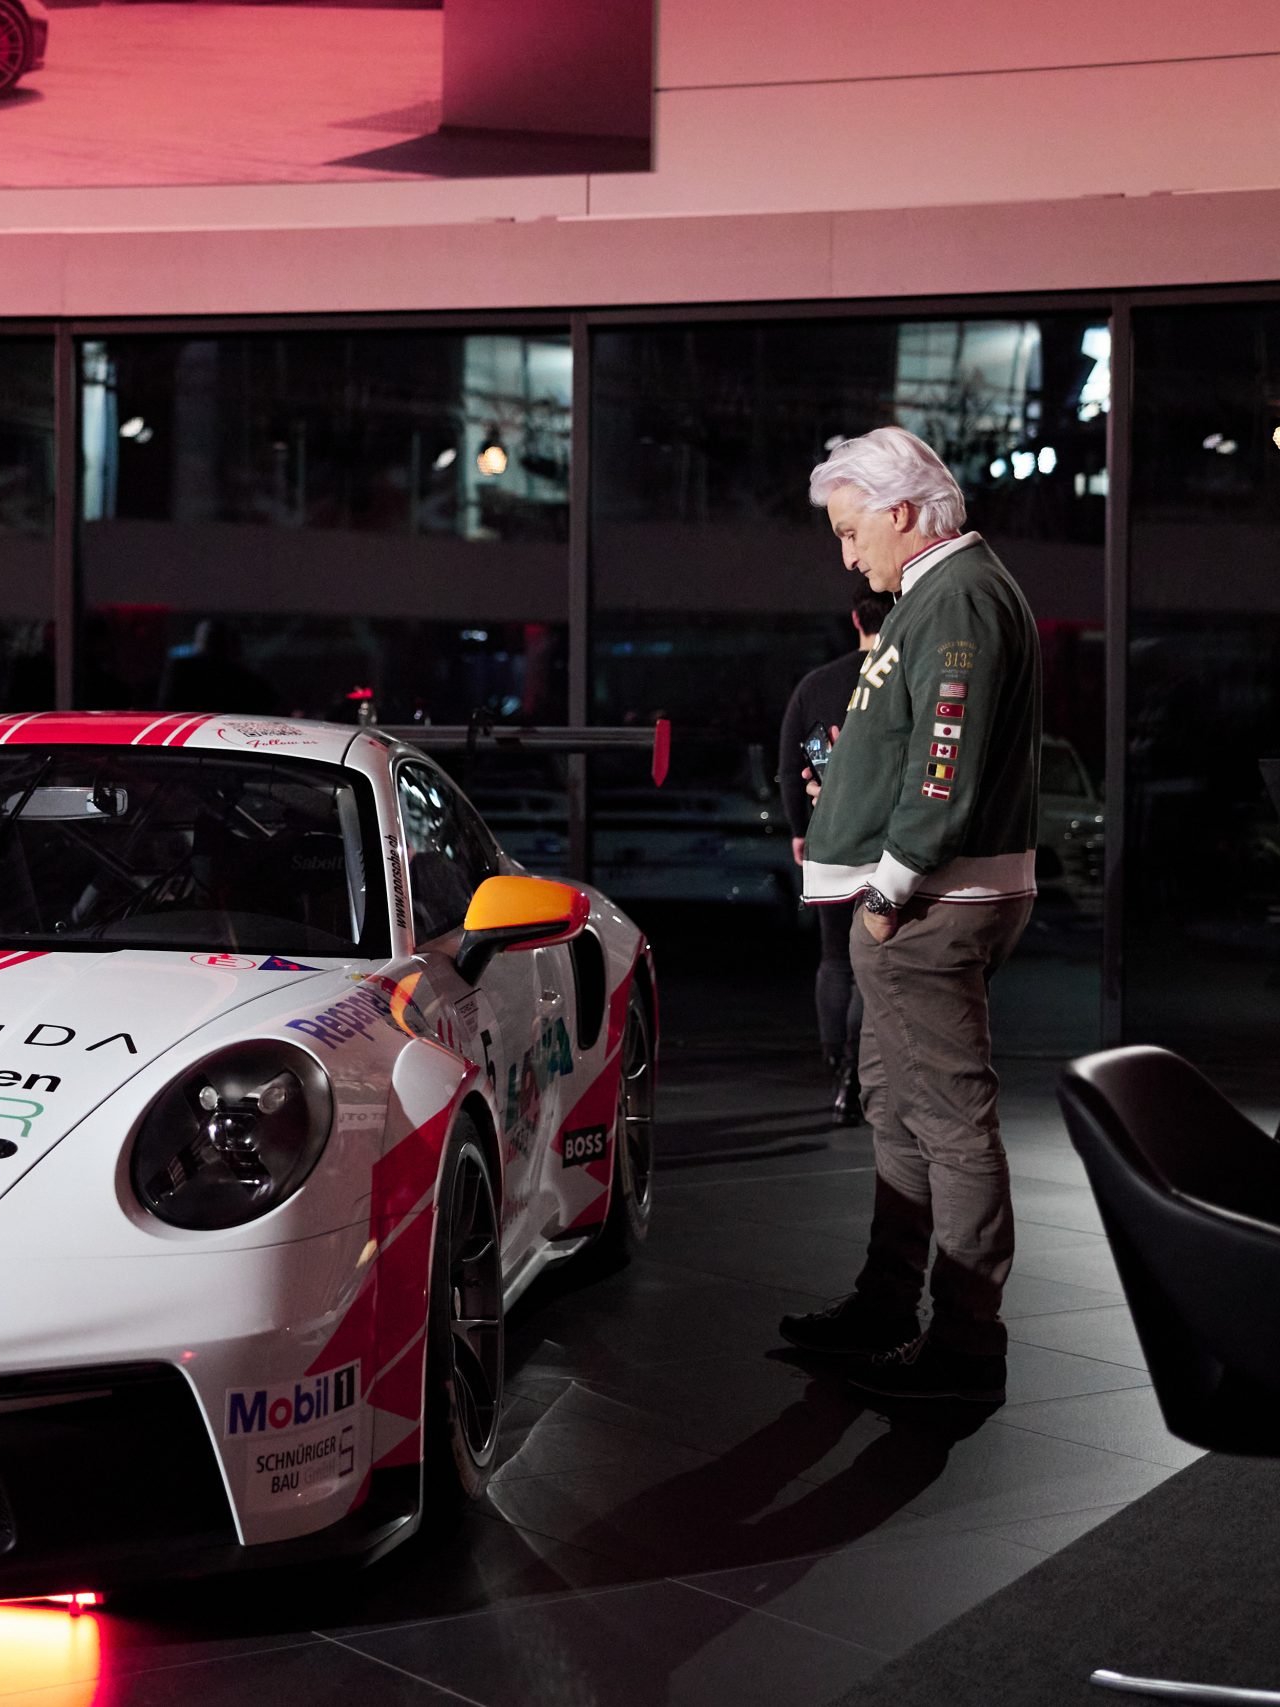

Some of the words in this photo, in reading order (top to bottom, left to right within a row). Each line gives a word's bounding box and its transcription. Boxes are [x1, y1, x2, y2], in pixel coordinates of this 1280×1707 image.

[384, 834, 407, 929] www.porsche.ch
[564, 1132, 603, 1160] BOSS
[228, 1376, 329, 1434] Mobil
[256, 1435, 336, 1474] SCHNÜRIGER
[271, 1471, 299, 1494] BAU
